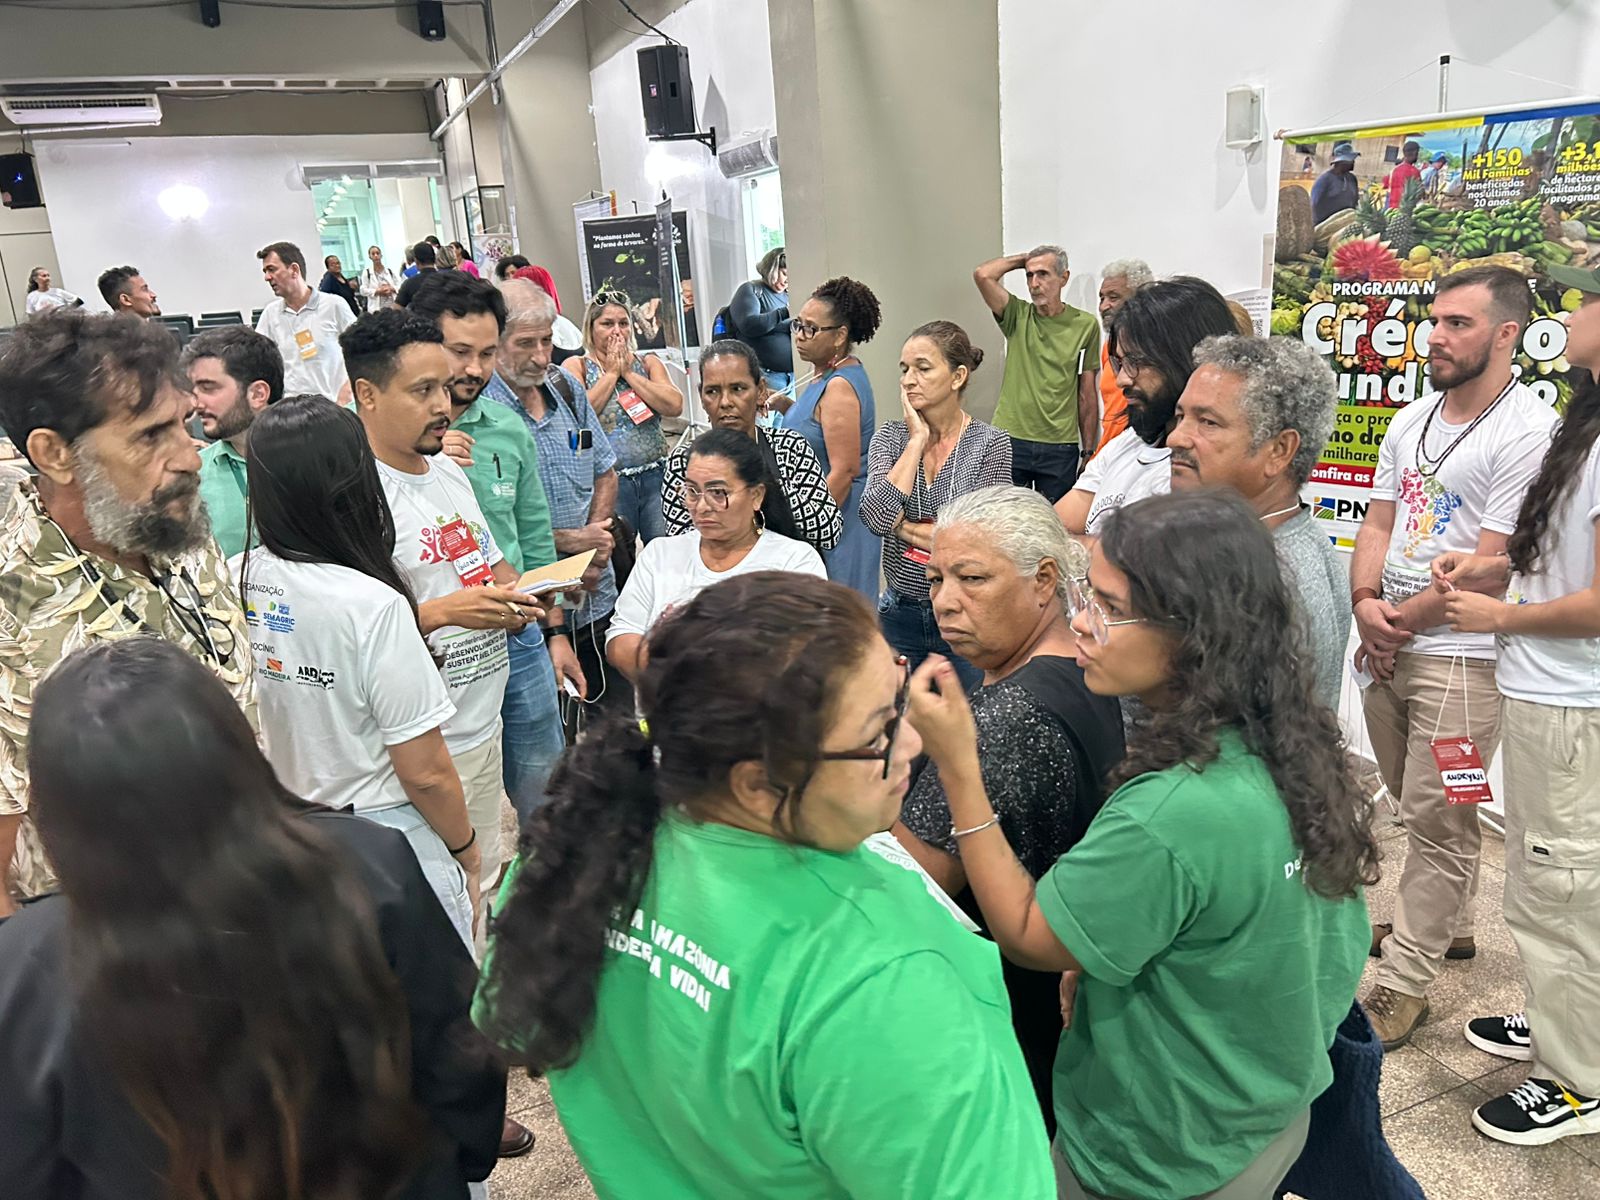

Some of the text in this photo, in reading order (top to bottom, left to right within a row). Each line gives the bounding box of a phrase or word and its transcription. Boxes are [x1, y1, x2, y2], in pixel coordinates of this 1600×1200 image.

[1472, 148, 1523, 168] +150
[1462, 166, 1531, 181] Mil Famílias
[1551, 174, 1563, 185] de
[1465, 179, 1525, 191] beneficiadas
[1540, 183, 1592, 195] facilitados
[1468, 188, 1521, 200] nos últimos
[1473, 199, 1512, 208] 20 anos.
[1332, 279, 1419, 297] PROGRAMA
[1311, 467, 1352, 482] onfira
[1354, 474, 1371, 484] as
